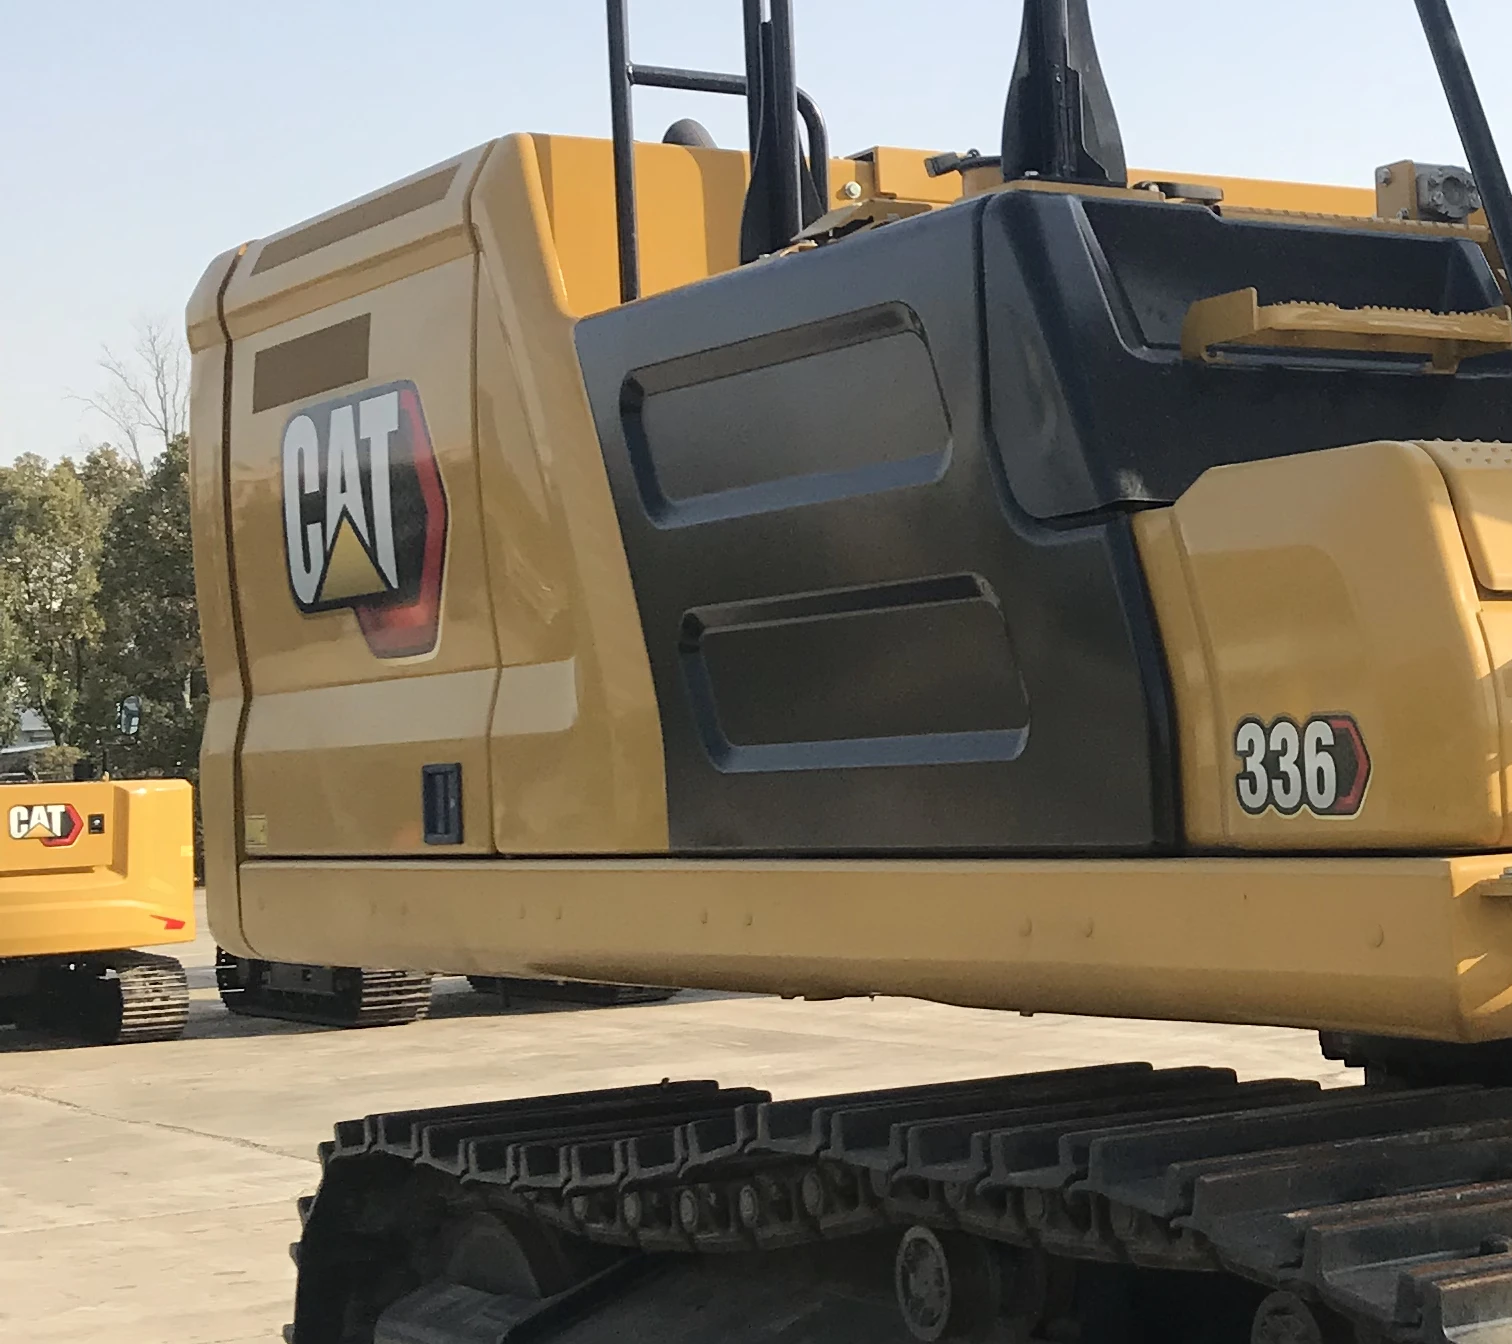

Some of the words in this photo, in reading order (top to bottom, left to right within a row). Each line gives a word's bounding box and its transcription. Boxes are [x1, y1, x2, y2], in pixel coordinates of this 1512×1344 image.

[283, 391, 399, 605] CAT
[1236, 720, 1337, 809] 336
[9, 804, 66, 839] CAT
